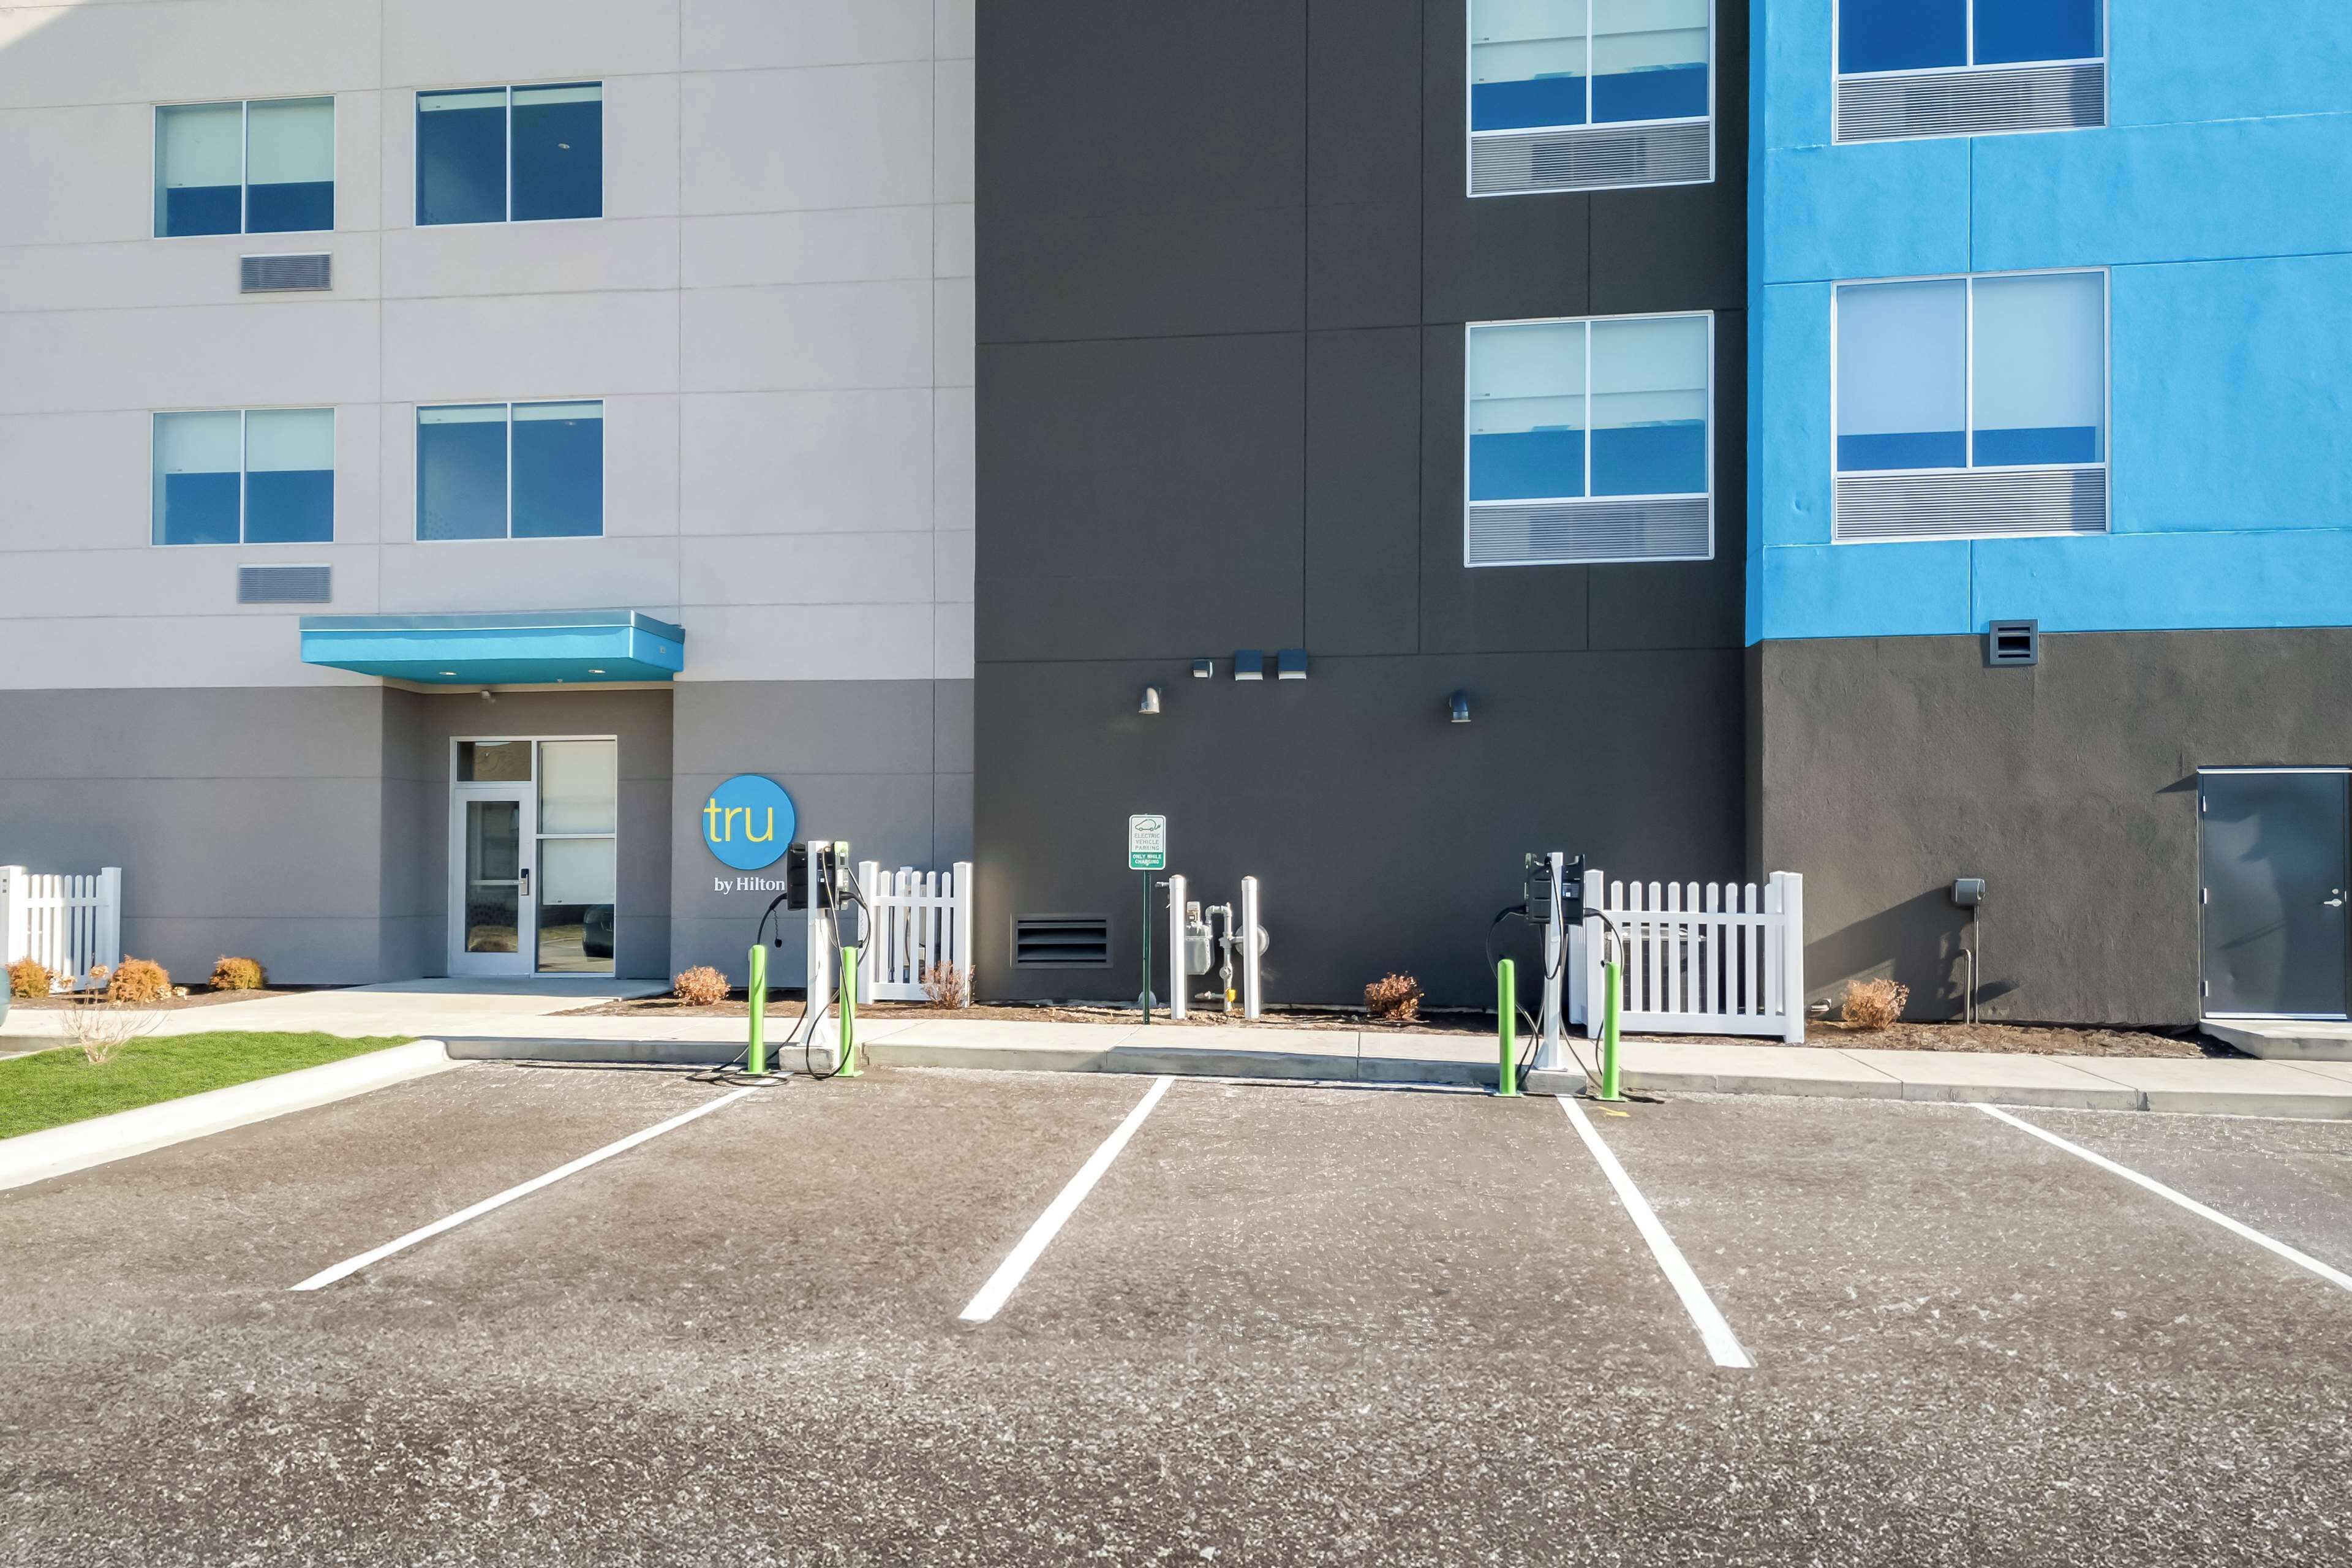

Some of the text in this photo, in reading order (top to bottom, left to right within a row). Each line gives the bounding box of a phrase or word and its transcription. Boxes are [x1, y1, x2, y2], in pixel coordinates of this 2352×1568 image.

[704, 798, 773, 842] tru
[714, 876, 785, 895] by Hilton
